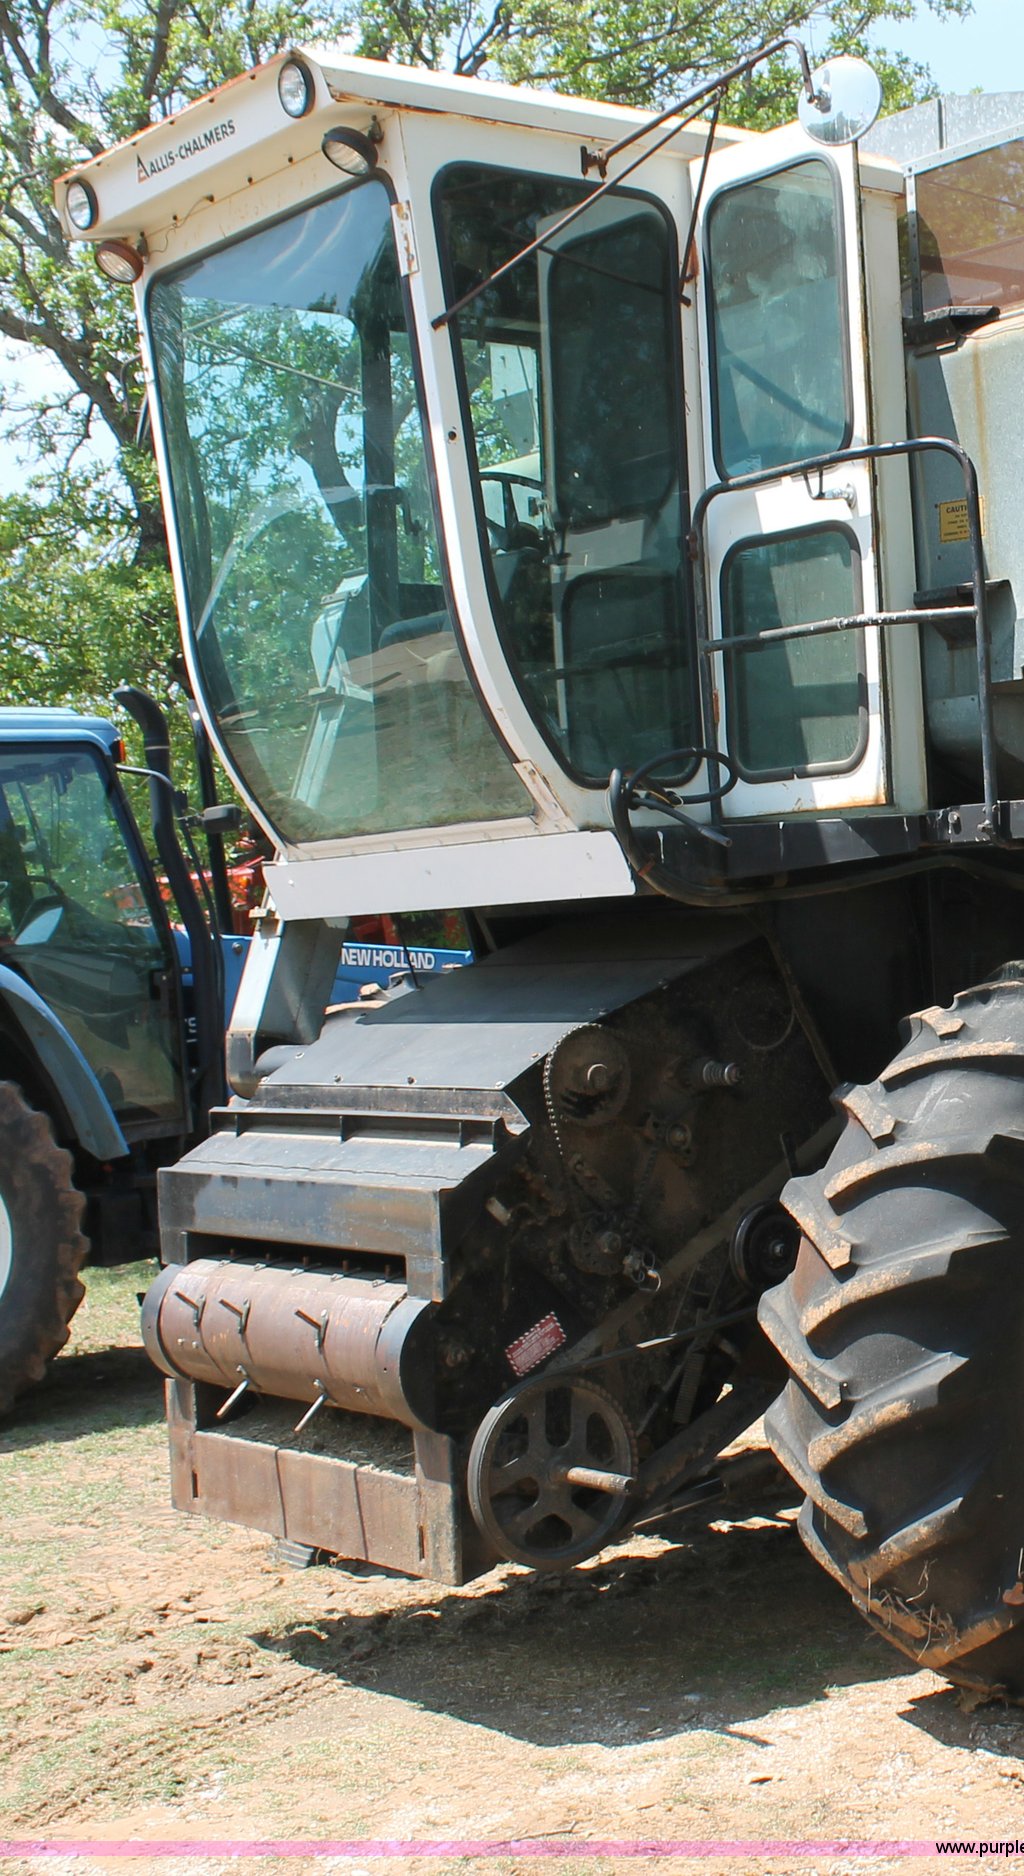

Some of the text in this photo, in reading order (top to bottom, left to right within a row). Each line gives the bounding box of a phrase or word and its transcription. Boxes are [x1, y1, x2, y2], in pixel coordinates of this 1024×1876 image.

[149, 119, 236, 177] ALLIS-CHALMERS
[946, 505, 967, 514] CAUTI
[341, 948, 435, 970] NEW HOLLAND
